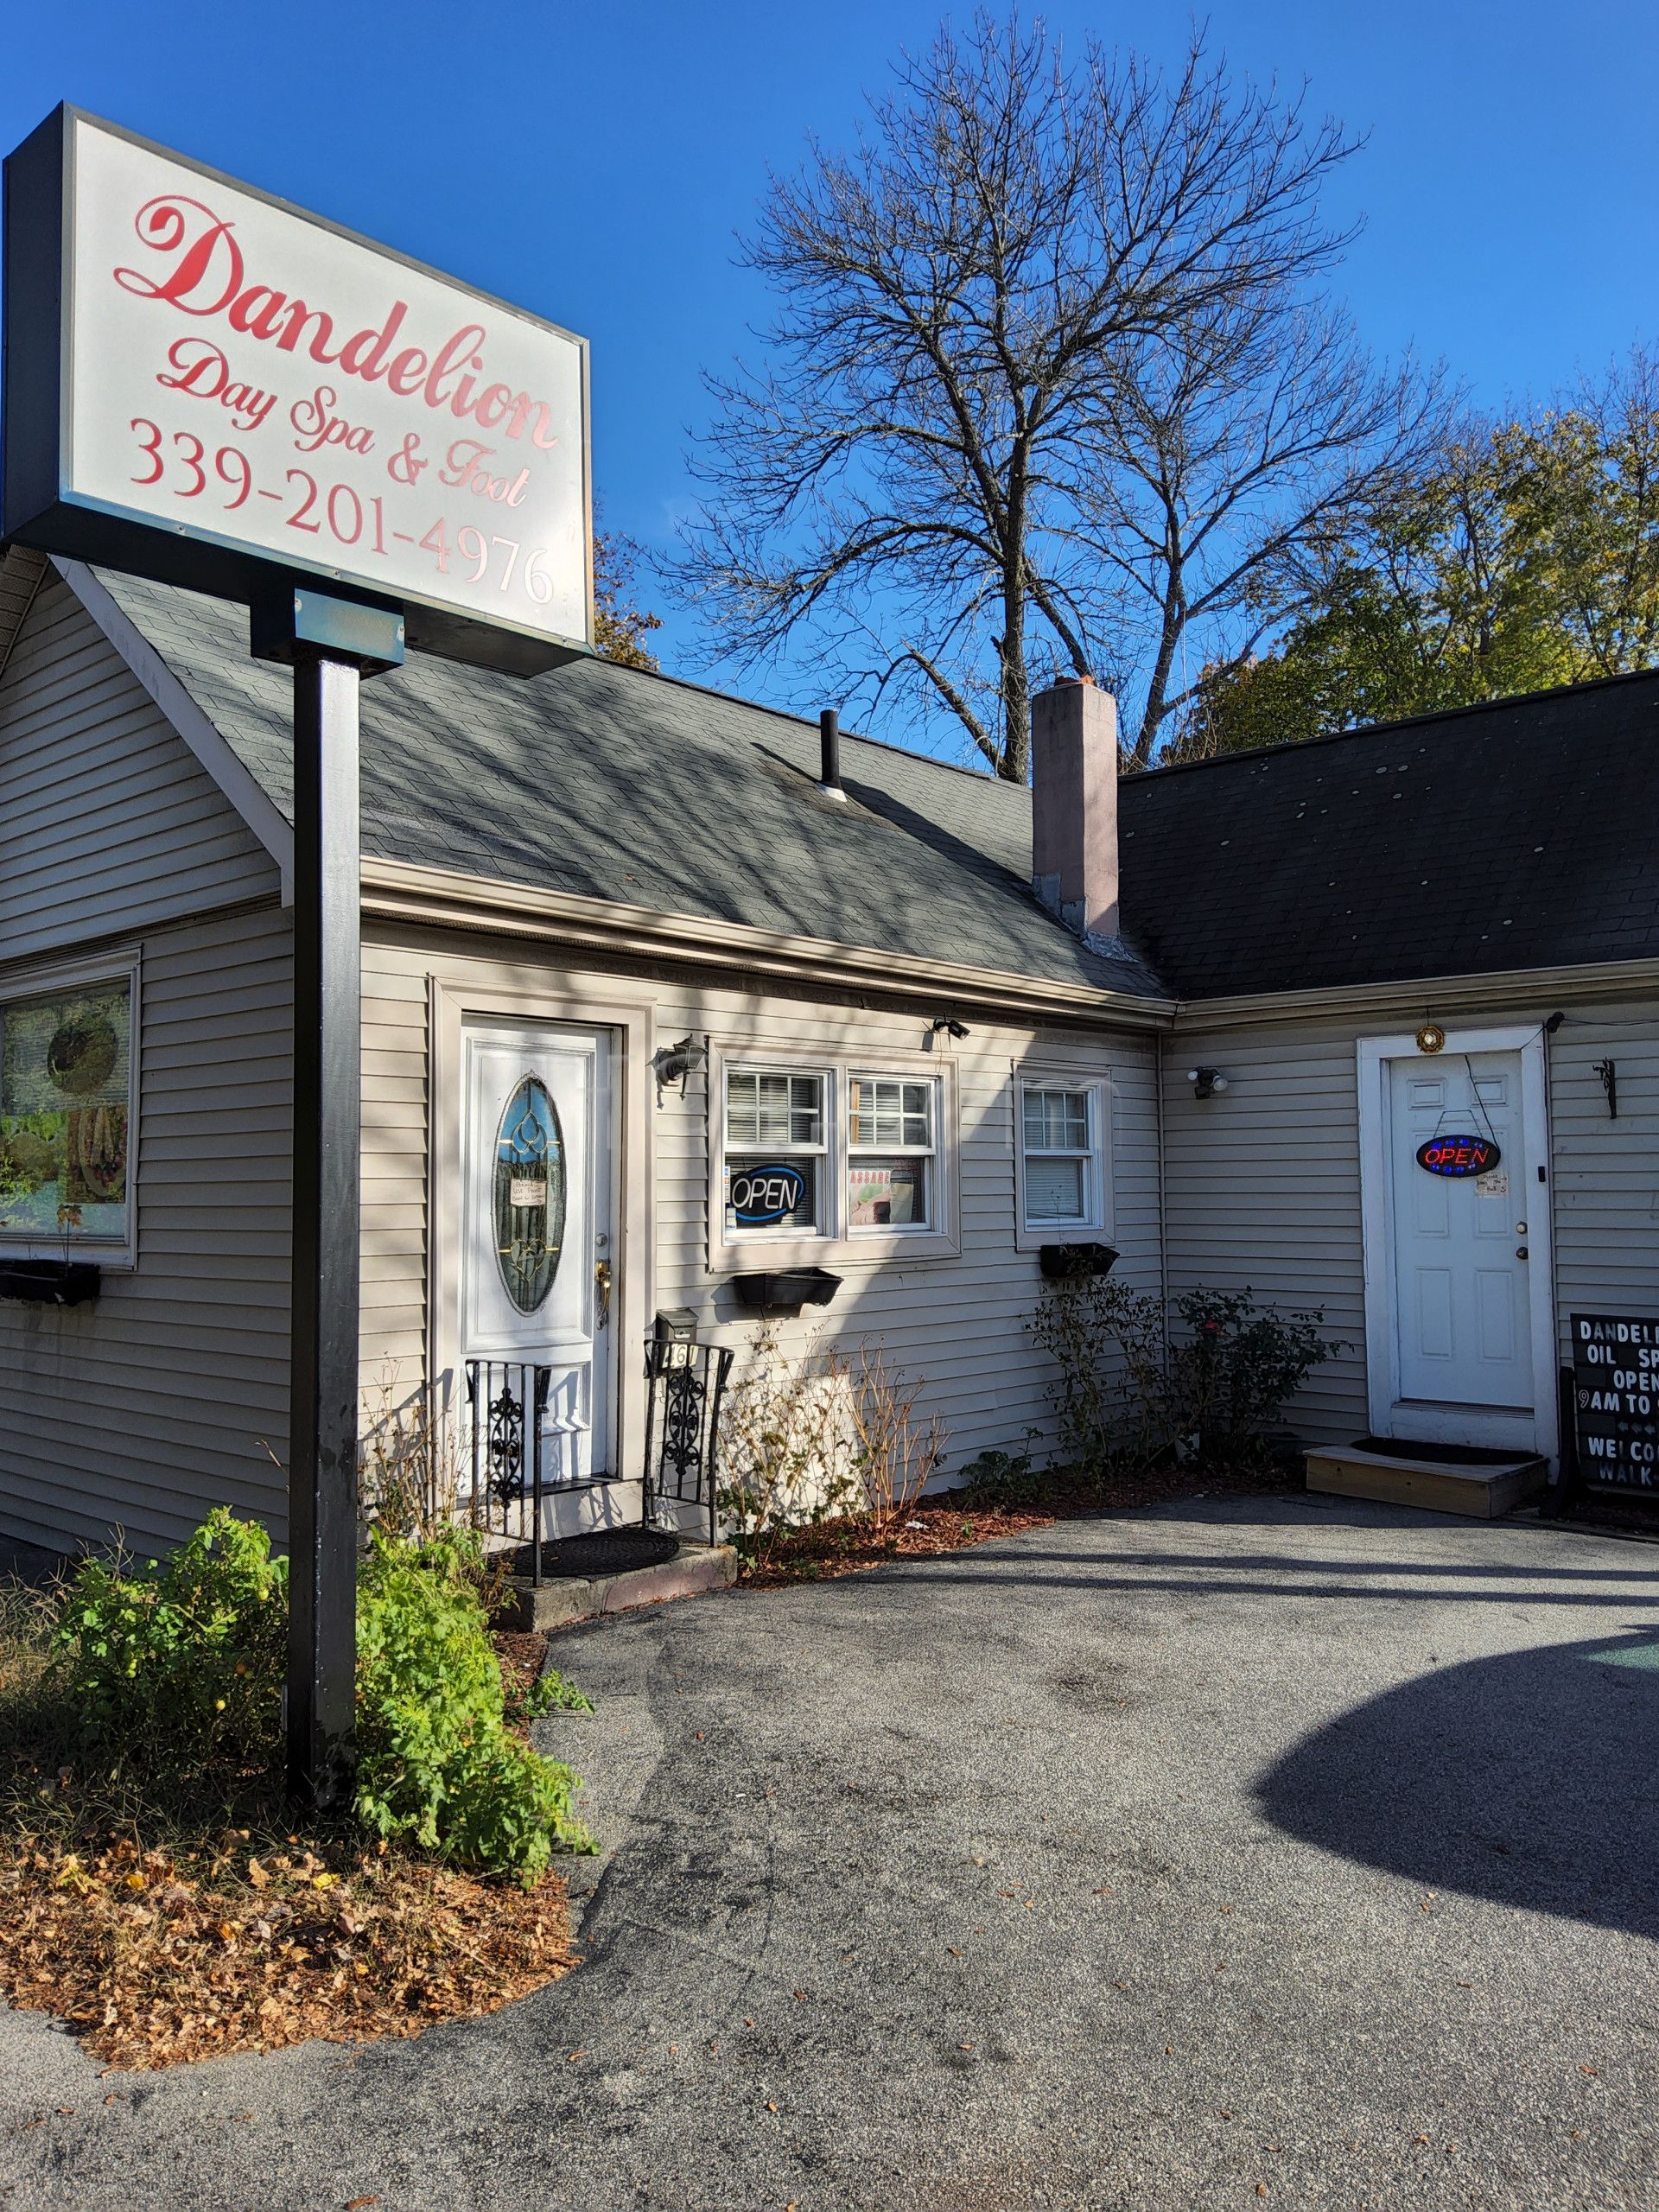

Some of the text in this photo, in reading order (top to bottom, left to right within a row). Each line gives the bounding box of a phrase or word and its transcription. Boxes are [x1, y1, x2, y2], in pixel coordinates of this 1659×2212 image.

[113, 194, 559, 449] Dandelion
[156, 337, 531, 508] Day Spa & Foot
[130, 417, 554, 605] 339-201-4976
[1424, 1147, 1490, 1164] OPEN
[731, 1177, 798, 1210] OPEN
[1586, 1344, 1617, 1365] OIL
[1613, 1370, 1659, 1392] OPEN
[1579, 1389, 1620, 1412] 9AM
[1625, 1393, 1650, 1414] TO
